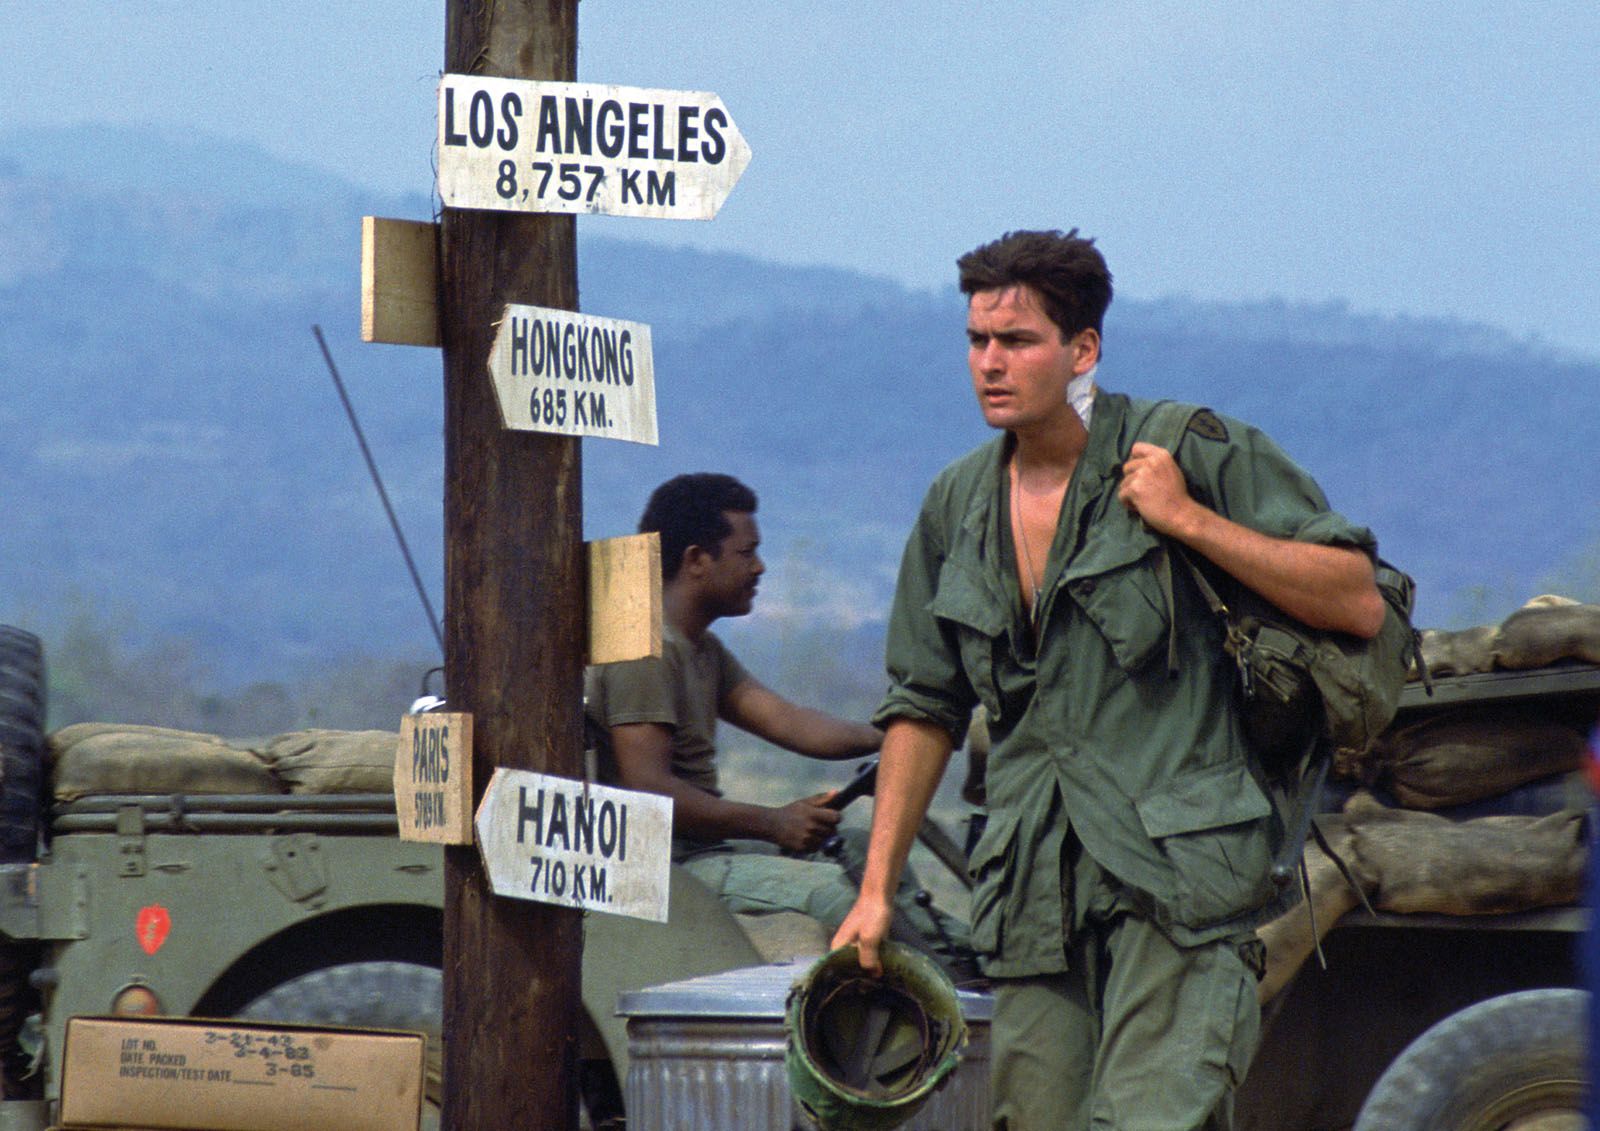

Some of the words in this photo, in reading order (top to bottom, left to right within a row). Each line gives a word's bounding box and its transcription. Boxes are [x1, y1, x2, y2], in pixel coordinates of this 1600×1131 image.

[445, 88, 523, 151] LOS
[536, 95, 728, 165] ANGELES
[496, 160, 604, 202] 8,757
[621, 169, 676, 206] KM
[511, 317, 634, 386] HONGKONG
[530, 387, 567, 426] 685
[574, 390, 613, 427] KM.
[412, 725, 449, 784] PARIS
[517, 786, 627, 861] HANOI
[530, 856, 566, 896] 710
[572, 864, 613, 903] KM.
[120, 1052, 143, 1064] DATE
[149, 1053, 187, 1067] PACKED
[121, 1039, 139, 1050] LOT
[207, 1070, 232, 1082] DATE
